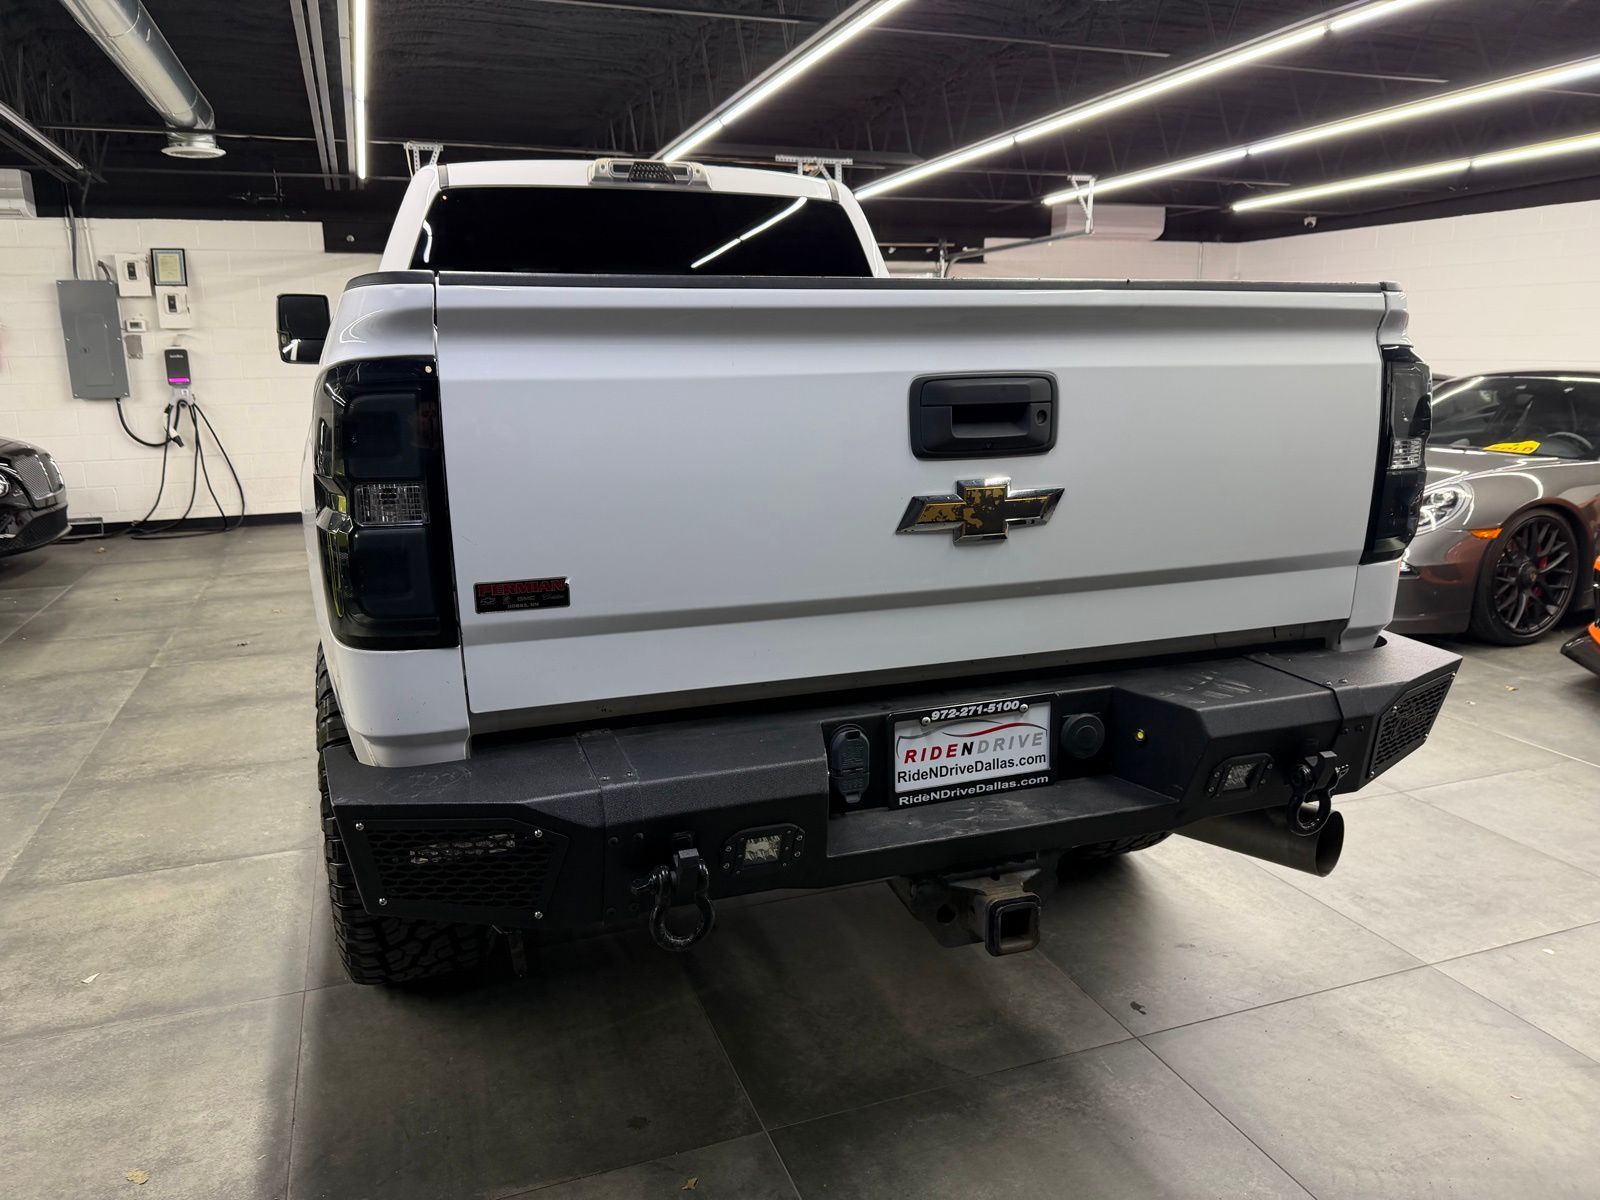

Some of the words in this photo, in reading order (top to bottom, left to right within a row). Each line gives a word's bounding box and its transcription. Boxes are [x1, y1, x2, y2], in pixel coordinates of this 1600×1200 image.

[479, 580, 564, 597] PERMIAN
[931, 700, 1020, 720] 972-271-5100
[897, 753, 1046, 784] RideNDriveDallas.com
[899, 775, 1049, 806] RideNDriveDallas.com
